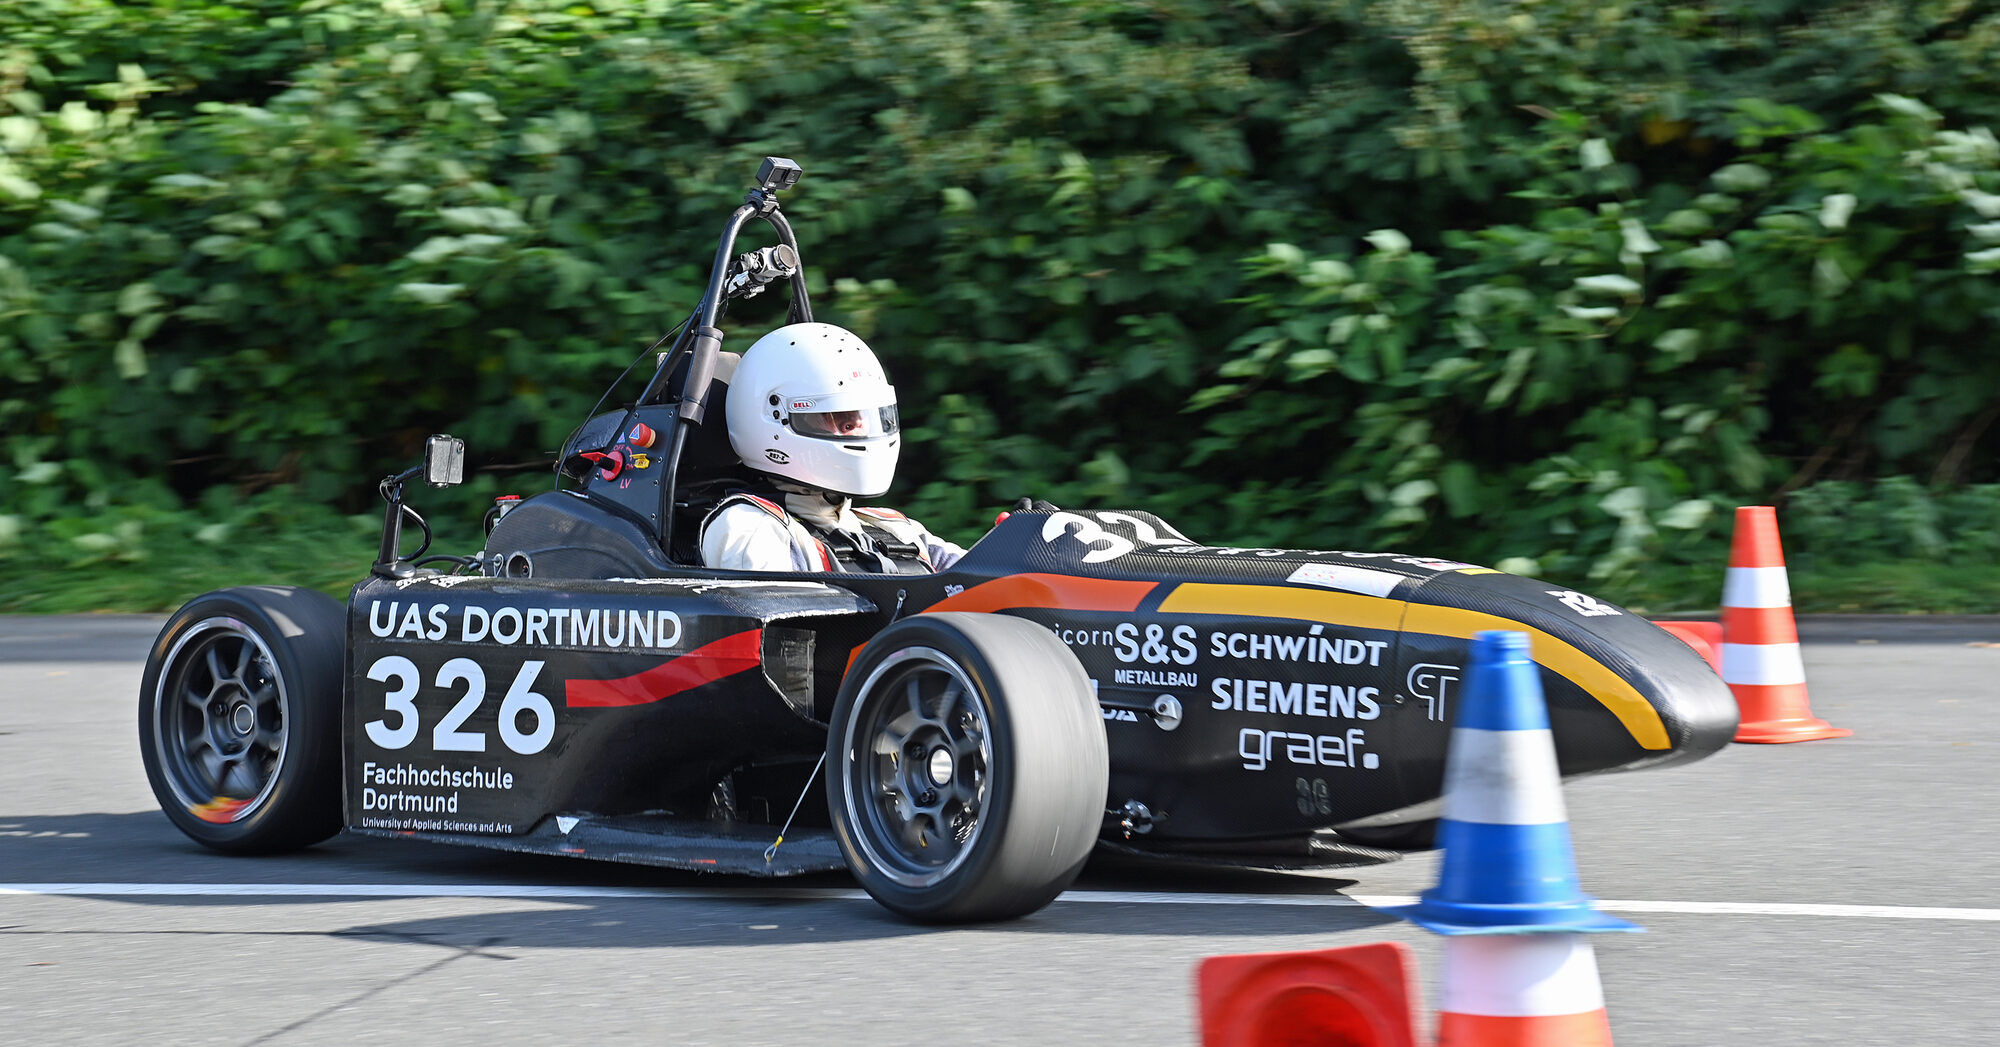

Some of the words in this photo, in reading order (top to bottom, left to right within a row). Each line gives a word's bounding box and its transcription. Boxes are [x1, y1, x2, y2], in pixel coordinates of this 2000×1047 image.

[620, 478, 632, 489] LV
[368, 600, 450, 641] UAS
[461, 605, 682, 648] DORTMUND
[1113, 623, 1198, 665] S&S
[1114, 669, 1198, 687] METALLBAU
[364, 655, 556, 755] 326
[1211, 678, 1381, 720] SIEMENS
[1238, 729, 1380, 771] graef.
[362, 762, 514, 790] Fachhochschule
[362, 788, 459, 813] Dortmund
[362, 817, 401, 829] University
[403, 818, 411, 829] of
[412, 819, 442, 830] Applied
[443, 821, 478, 831] Sciences
[479, 823, 494, 833] and
[495, 823, 512, 834] Arts
